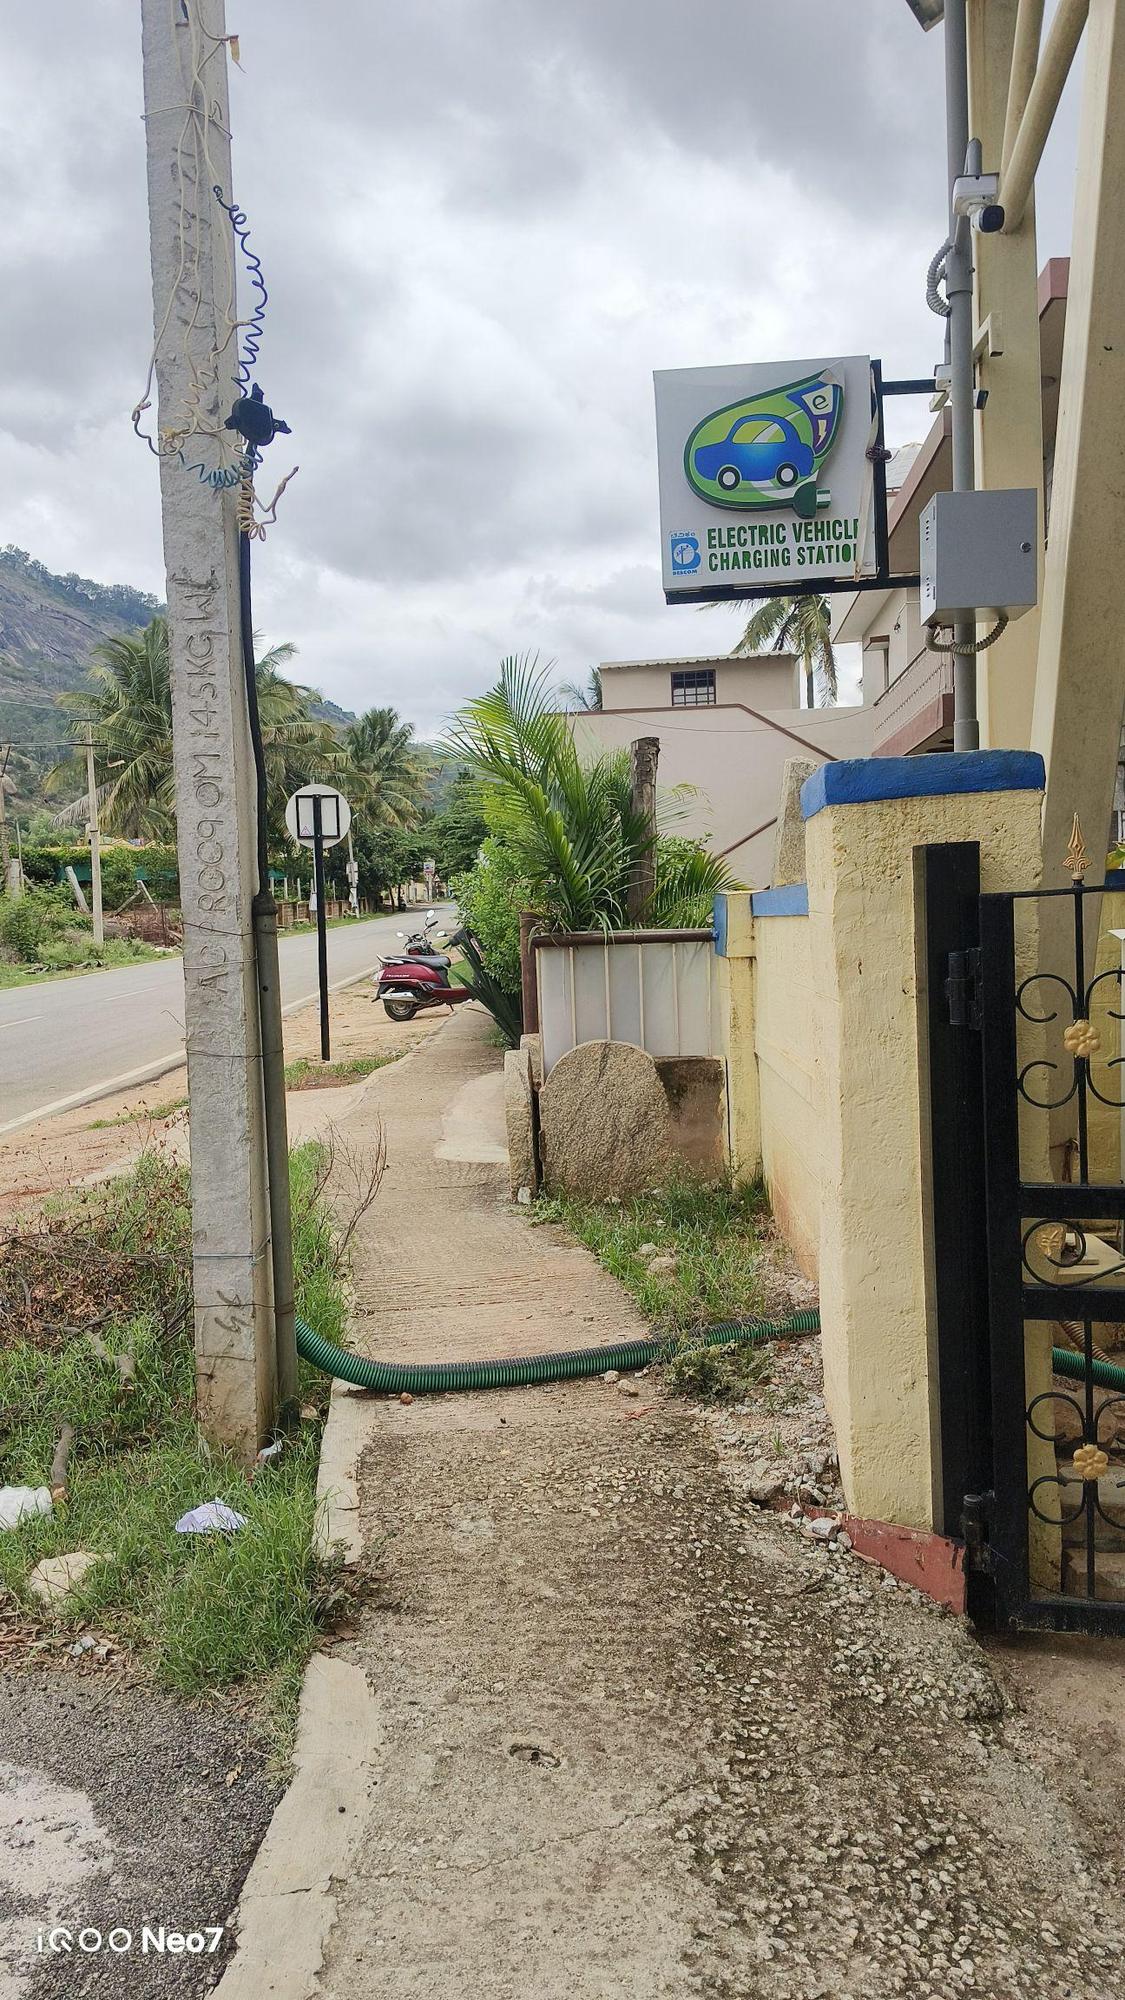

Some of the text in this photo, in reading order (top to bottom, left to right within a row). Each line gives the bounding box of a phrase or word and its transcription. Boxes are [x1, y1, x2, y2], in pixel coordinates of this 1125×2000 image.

[707, 523, 786, 549] ELECTRIC
[708, 543, 857, 572] CHARGING STATIO
